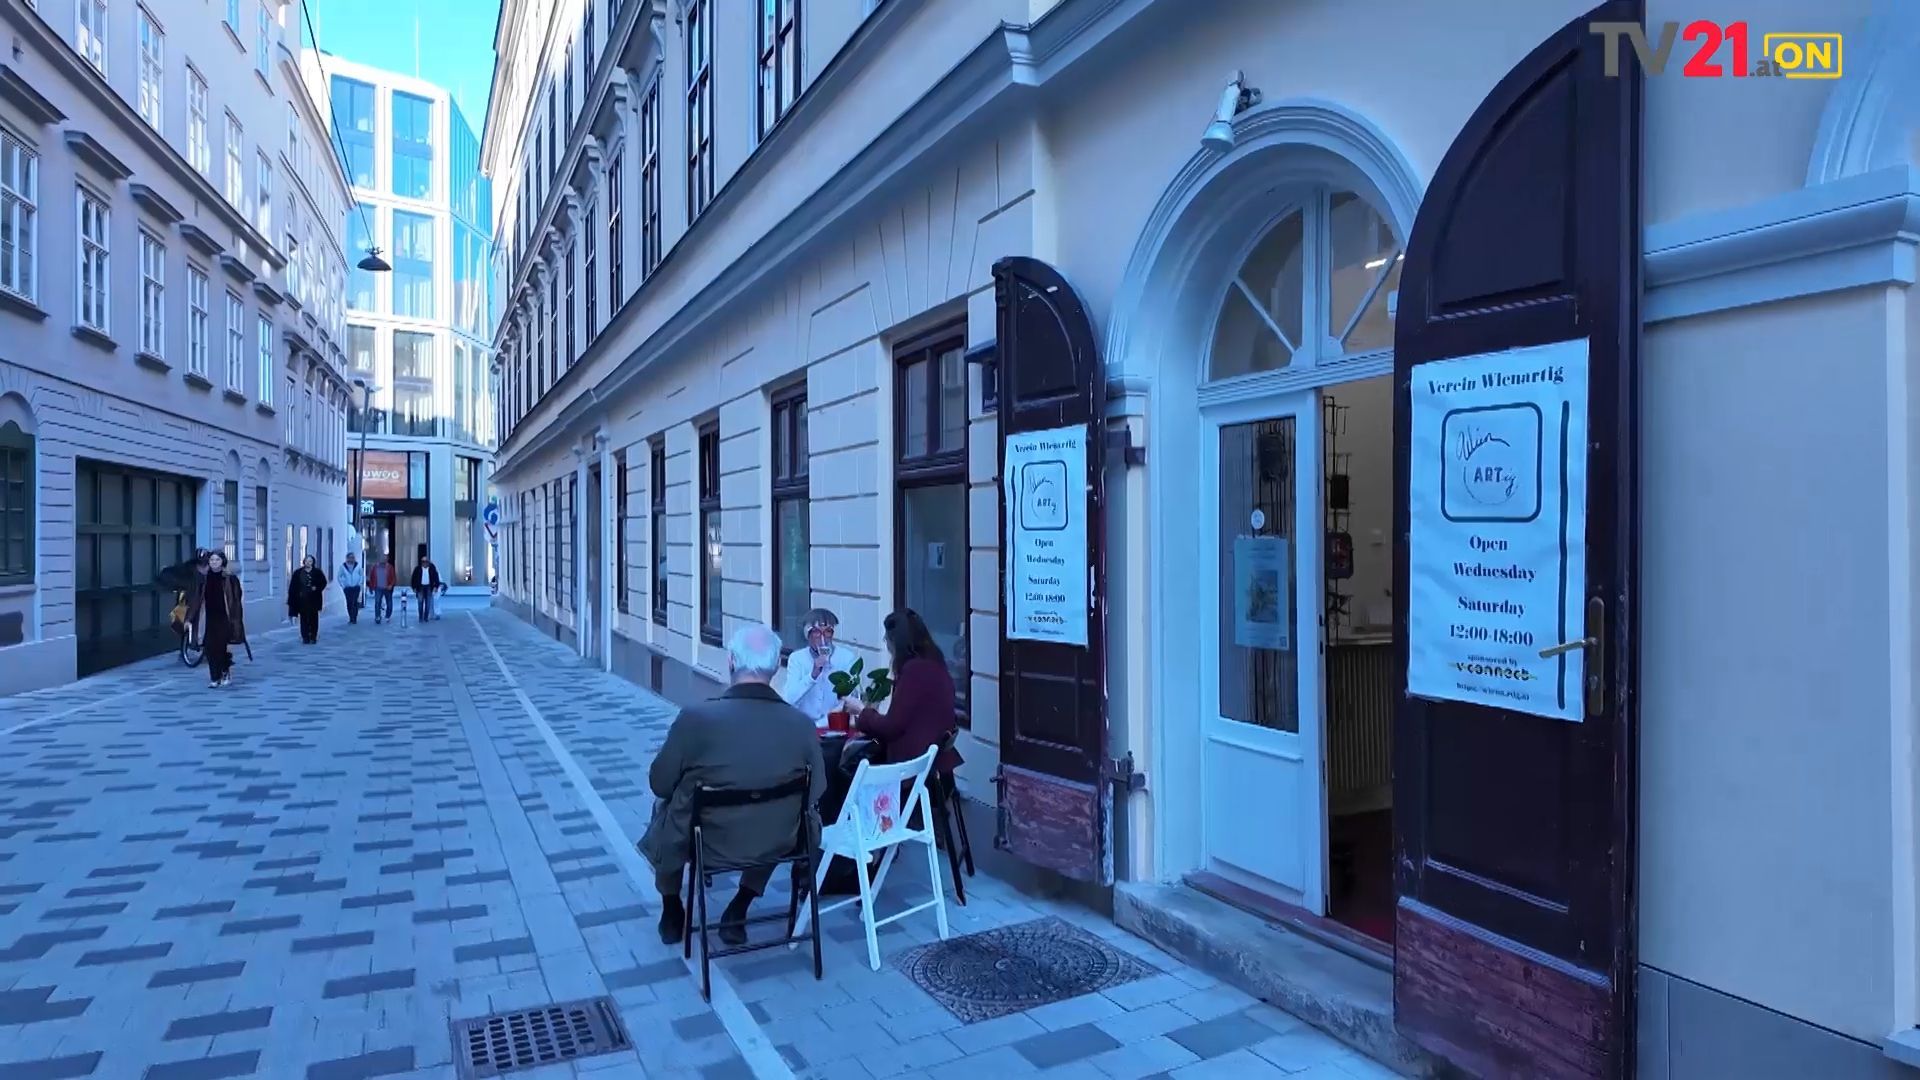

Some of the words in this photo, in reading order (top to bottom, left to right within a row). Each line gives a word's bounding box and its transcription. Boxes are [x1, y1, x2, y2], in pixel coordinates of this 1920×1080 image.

[1428, 377, 1476, 395] Verein
[1482, 366, 1564, 389] Wienartig
[1034, 538, 1054, 549] Open
[1469, 534, 1508, 553] Open
[1026, 554, 1065, 566] Wednesday
[1028, 574, 1061, 587] Saturday
[1453, 562, 1537, 583] Wednesday
[1457, 595, 1526, 618] Saturday
